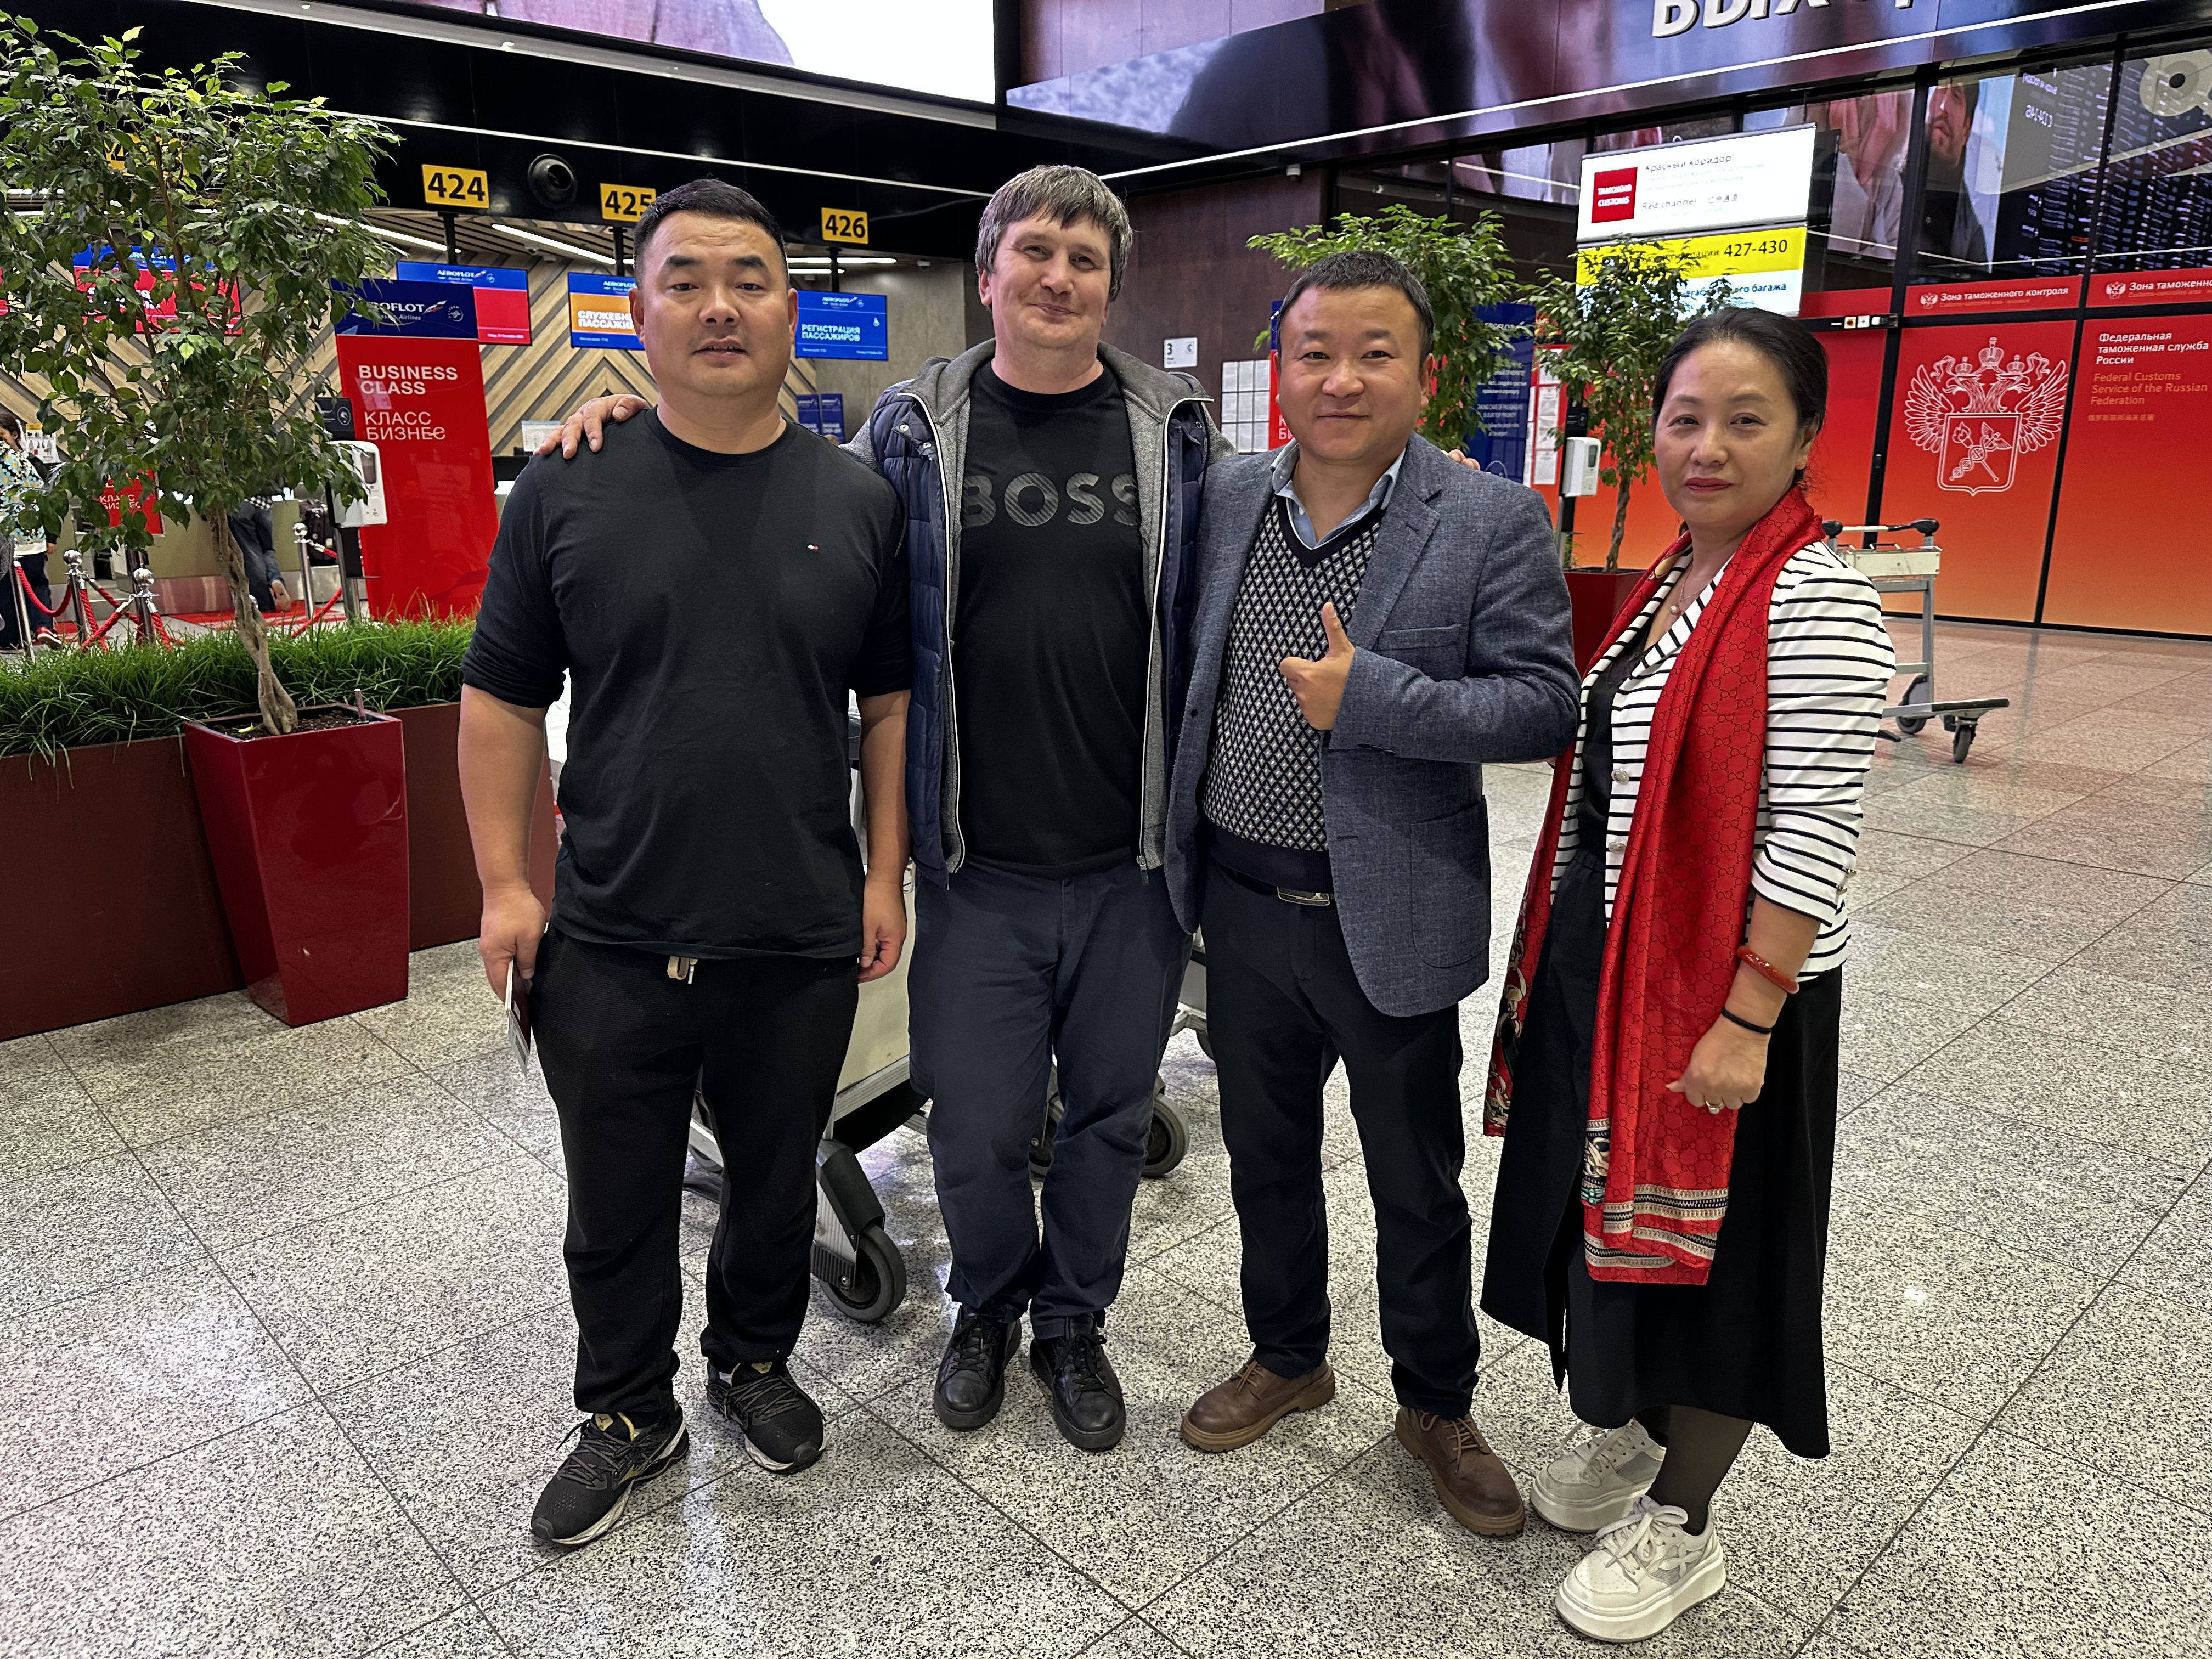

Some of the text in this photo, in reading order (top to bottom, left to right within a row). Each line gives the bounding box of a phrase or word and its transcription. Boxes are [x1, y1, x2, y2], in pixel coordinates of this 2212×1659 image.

[428, 172, 485, 201] 424
[1661, 196, 1697, 208] channel
[825, 214, 865, 238] 426
[1724, 239, 1788, 257] 427-430
[1752, 284, 1787, 292] багажа
[2129, 282, 2154, 291] Зона
[1940, 287, 2069, 301] Зона таможенного контроля
[801, 324, 861, 334] РЕГИСТРАЦИЯ
[802, 332, 860, 341] ПАССАЖИРОВ
[2099, 332, 2172, 343] Федеральная
[1167, 343, 1173, 356] 3
[2098, 340, 2209, 353] таможенная служба
[2096, 356, 2134, 364] России
[358, 365, 458, 380] BUSINESS
[2093, 372, 2181, 382] Federal Customs
[360, 381, 426, 395] CLASS
[2091, 383, 2208, 393] Service of the Russian
[2091, 396, 2145, 405] Federation
[364, 411, 432, 425] КЛАСС
[366, 427, 446, 440] БИЗНЕС
[963, 472, 1139, 528] BOSS
